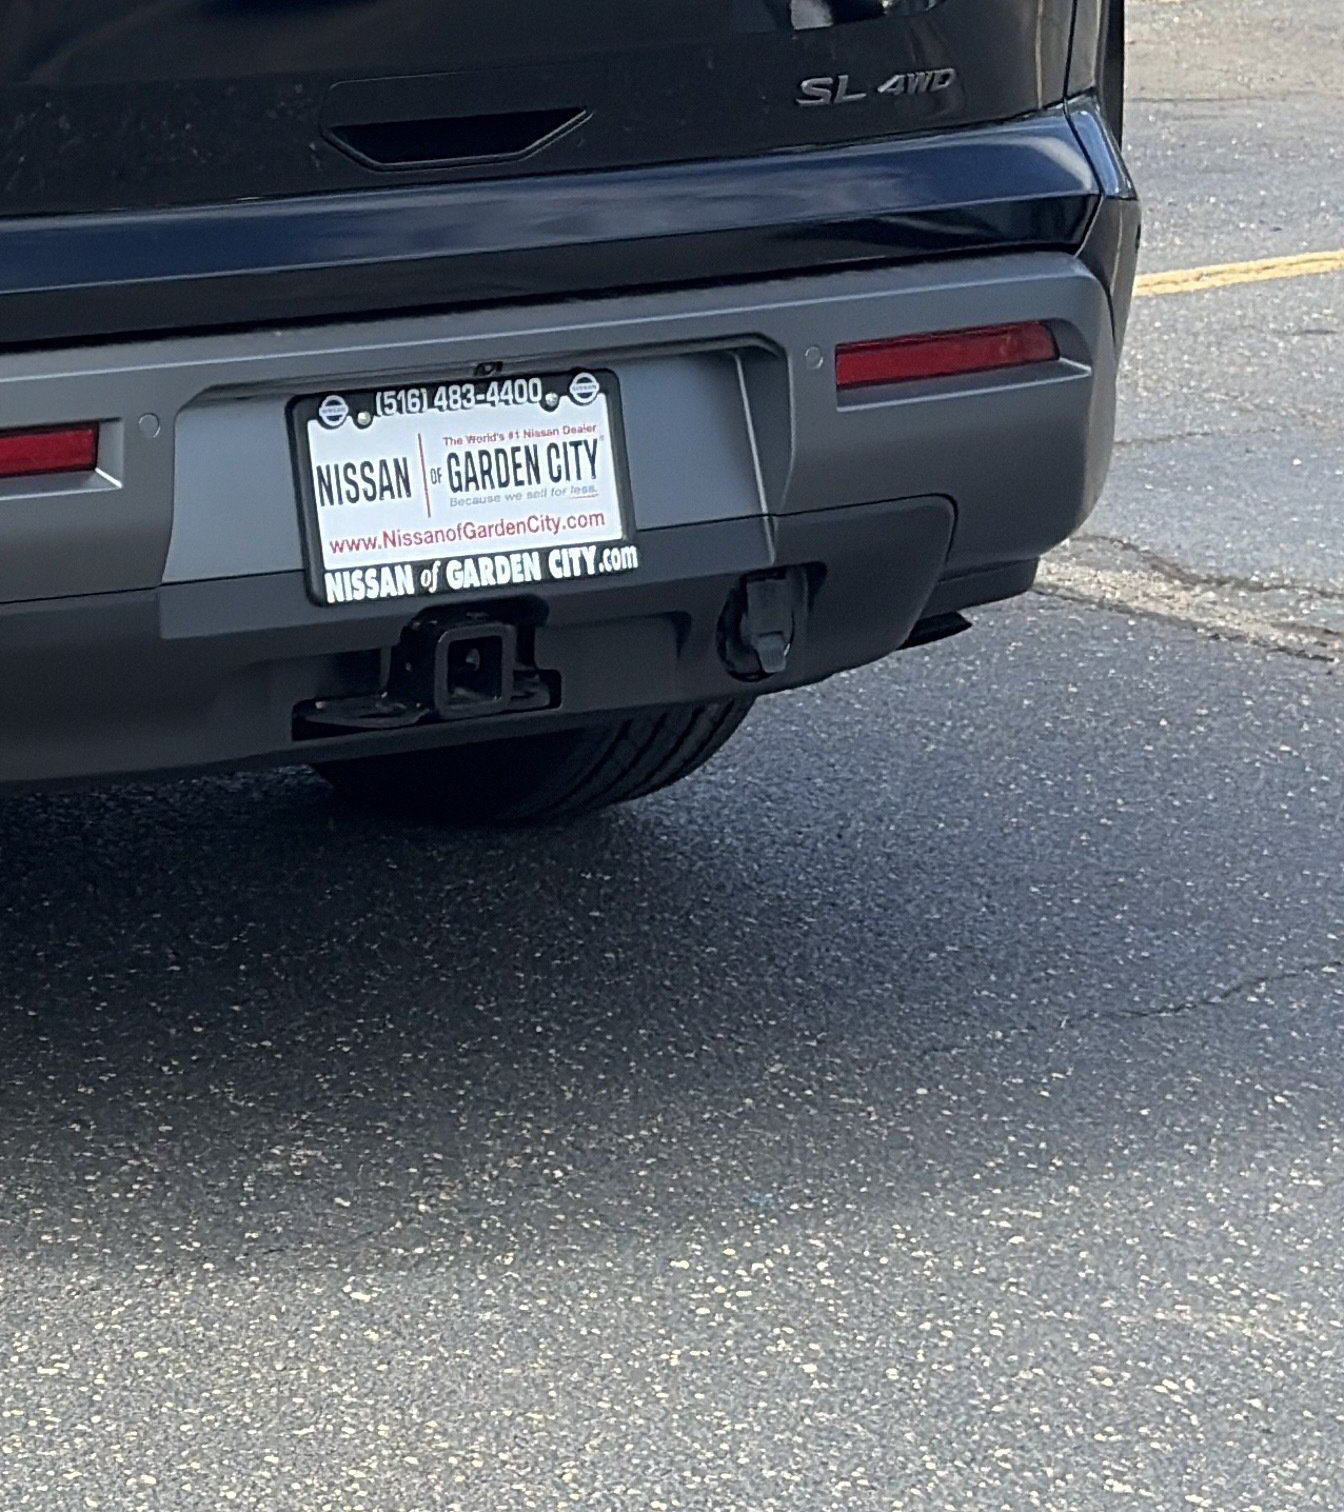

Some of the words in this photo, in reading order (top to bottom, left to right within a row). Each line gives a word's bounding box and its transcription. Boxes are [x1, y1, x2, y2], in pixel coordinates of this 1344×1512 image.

[796, 74, 867, 106] SL
[877, 68, 956, 96] 4WD
[375, 388, 428, 417] (516)
[434, 378, 543, 412] 483-4400
[443, 435, 464, 447] The
[466, 431, 506, 445] World's
[523, 427, 559, 439] Nissan
[563, 423, 597, 435] Dealer
[315, 456, 412, 507] NISSAN
[430, 467, 443, 485] OF
[446, 442, 541, 493] GARDEN
[546, 438, 600, 484] CITY
[449, 493, 502, 507] Because
[504, 492, 523, 502] we
[525, 487, 548, 500] sell
[550, 486, 567, 498] for
[329, 511, 606, 555] www.NissanofGardenCity.com
[324, 563, 416, 604] NISSAN
[420, 560, 441, 594] of
[445, 551, 542, 591] GARDEN
[548, 544, 639, 580] CITY.com
